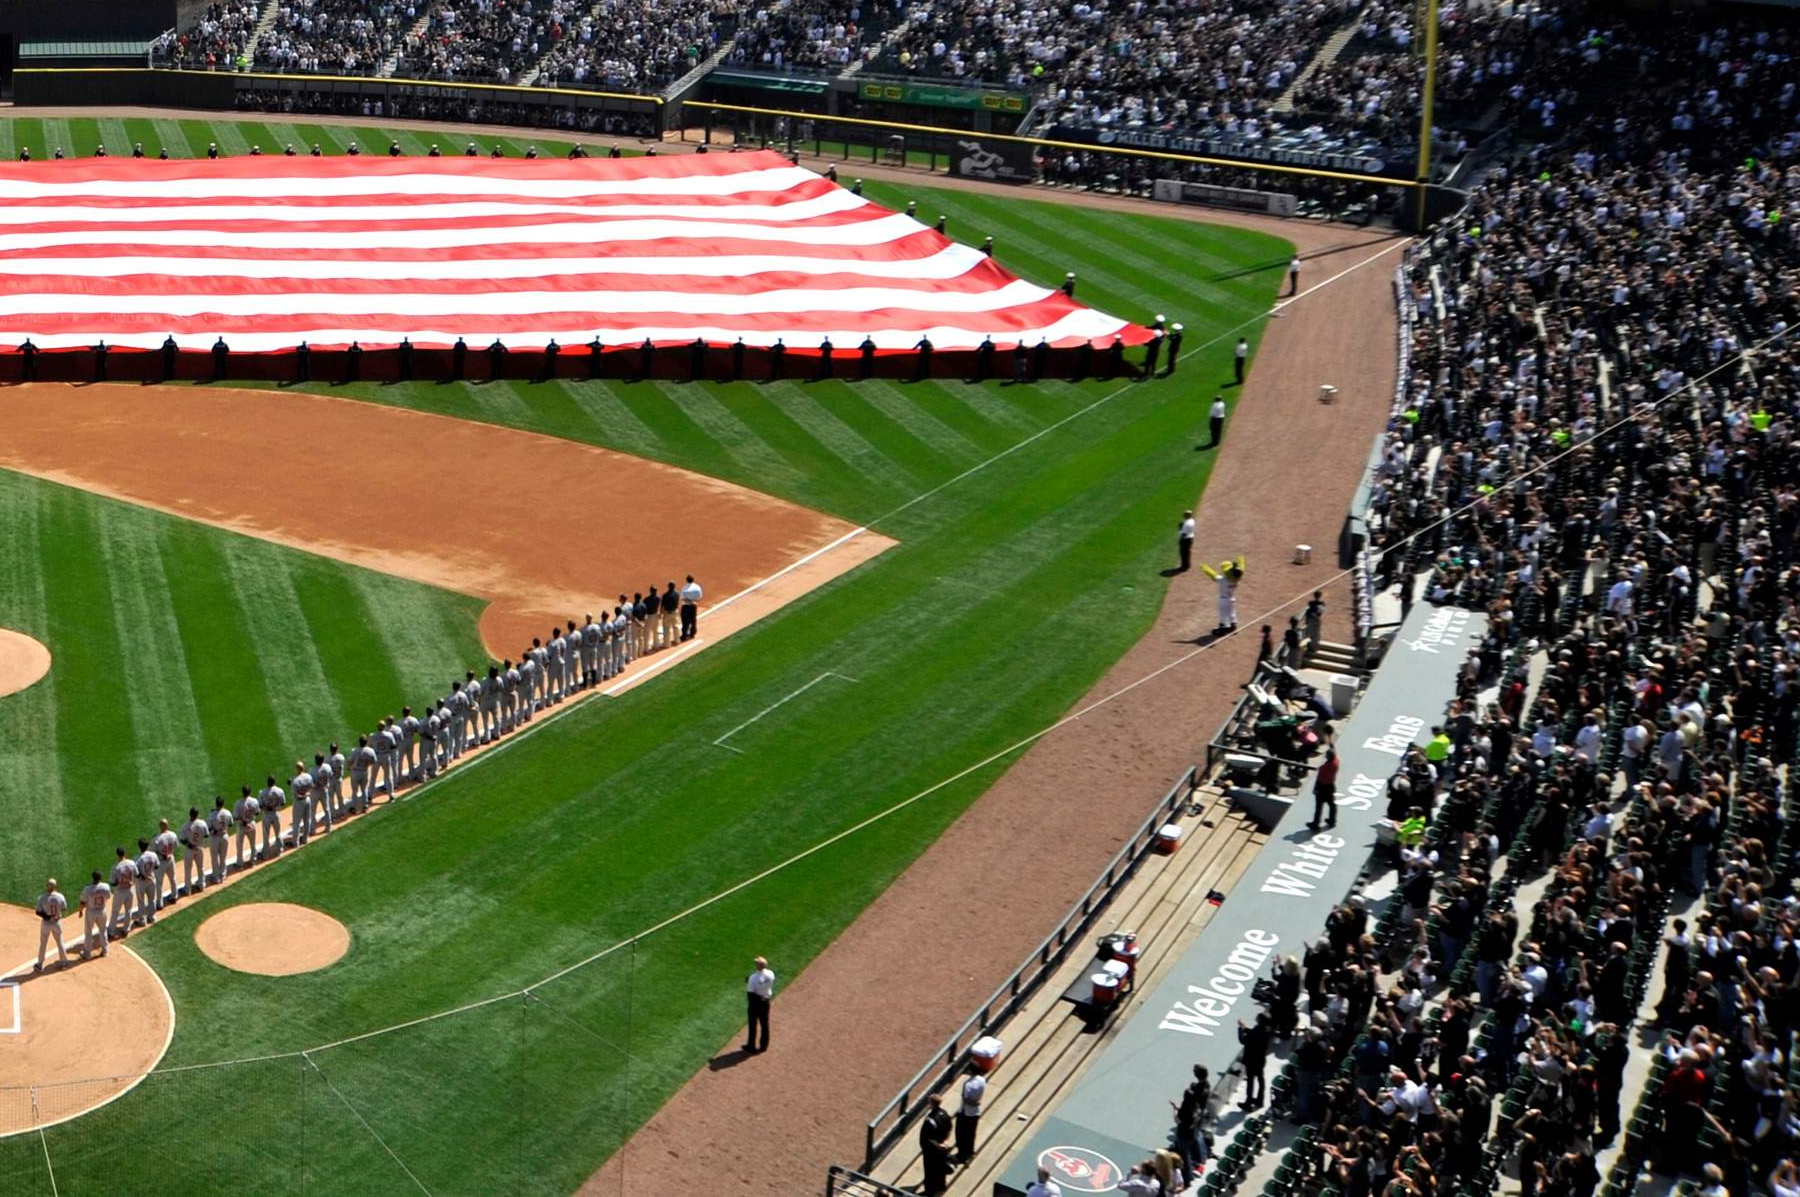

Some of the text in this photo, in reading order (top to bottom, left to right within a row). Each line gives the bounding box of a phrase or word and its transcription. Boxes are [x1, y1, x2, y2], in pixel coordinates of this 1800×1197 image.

[1159, 715, 1425, 1036] Welcome White Sox Fans
